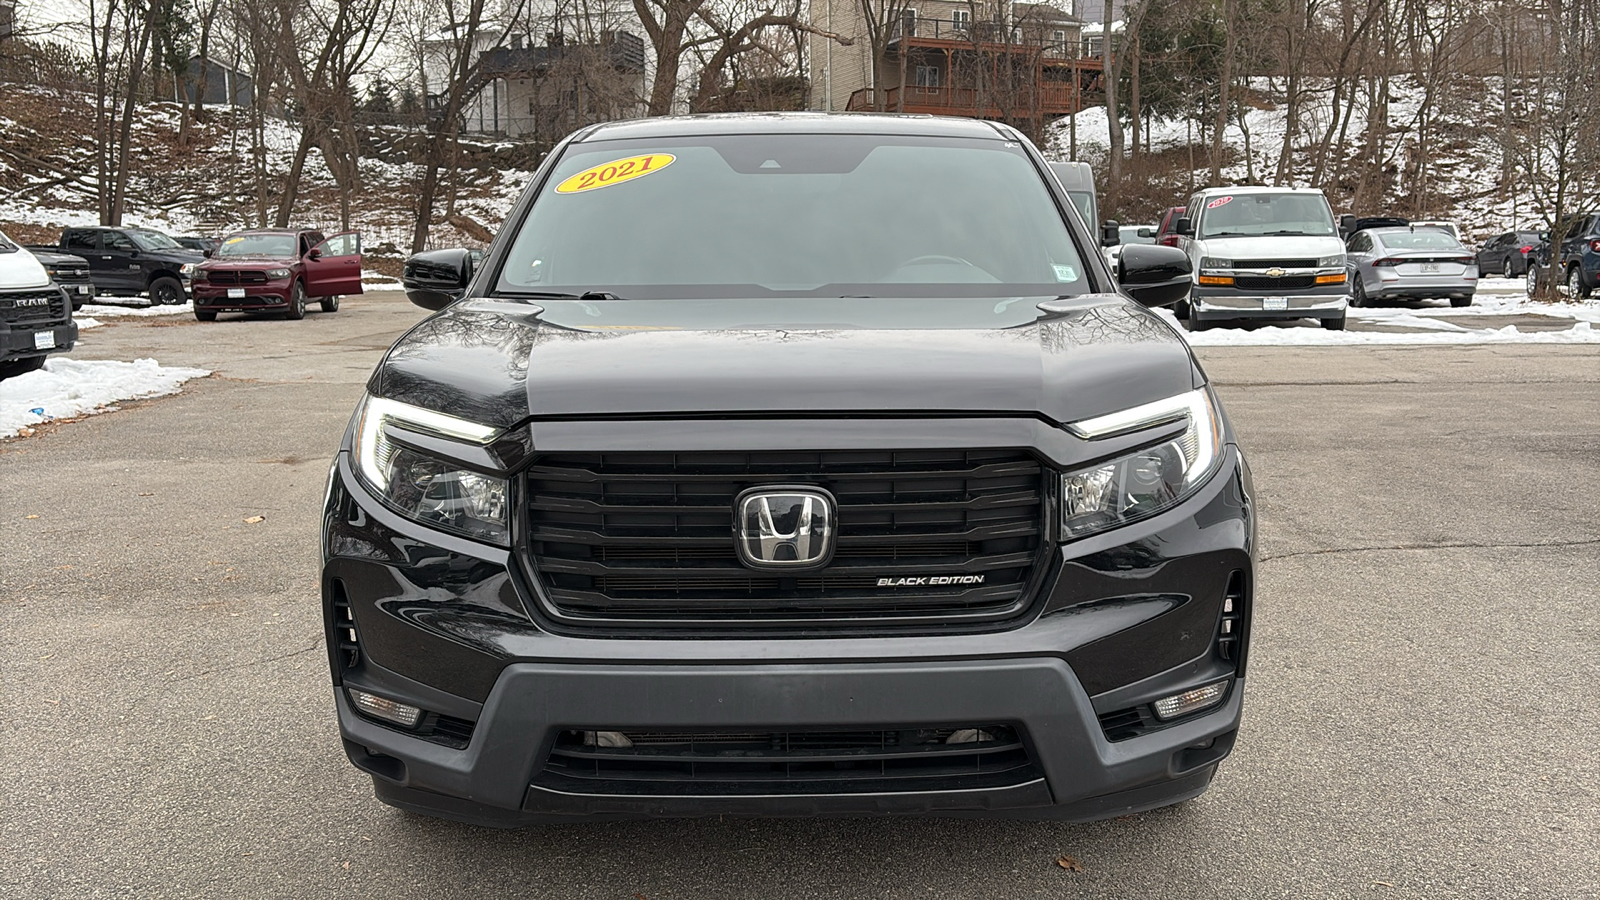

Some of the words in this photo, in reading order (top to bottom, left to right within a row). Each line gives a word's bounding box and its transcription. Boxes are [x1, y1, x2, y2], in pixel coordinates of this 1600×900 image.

[577, 156, 653, 189] 2021
[16, 298, 49, 307] RAM
[877, 577, 927, 586] BLACK
[929, 575, 984, 585] EDITION
